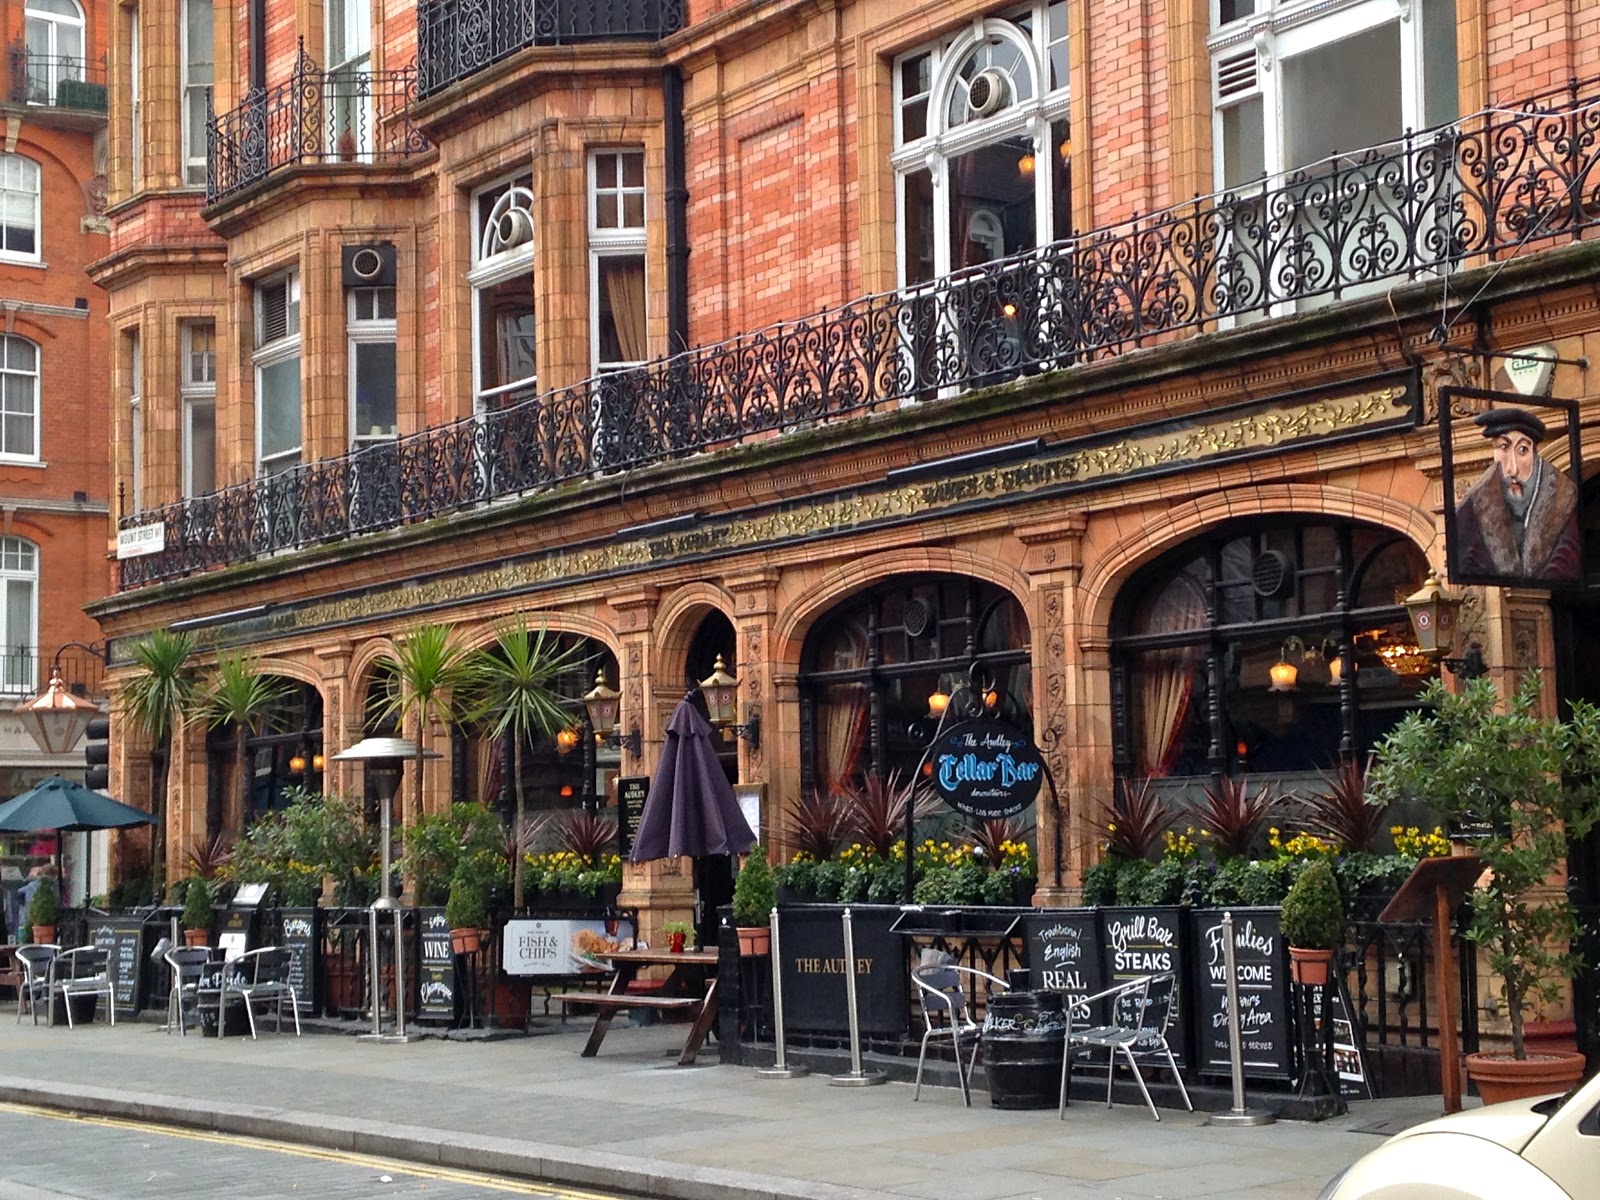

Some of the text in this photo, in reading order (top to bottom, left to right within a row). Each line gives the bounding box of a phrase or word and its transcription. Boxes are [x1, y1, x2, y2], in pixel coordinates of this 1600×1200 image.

[120, 531, 137, 545] MOUNT
[138, 528, 154, 542] STREET
[963, 732, 1012, 753] The Audley
[938, 753, 1040, 791] Cellar Bar
[519, 936, 559, 947] FISH &
[1038, 923, 1083, 943] Traditional
[1108, 915, 1174, 953] Grill Bar
[424, 941, 449, 959] WINE
[519, 948, 557, 960] CHIPS
[1044, 942, 1081, 962] English
[795, 958, 873, 973] THE AUDEY
[1115, 952, 1172, 970] STEAKS
[1042, 971, 1088, 989] REAL
[1209, 966, 1273, 981] WECOME
[1246, 1008, 1273, 1027] Area
